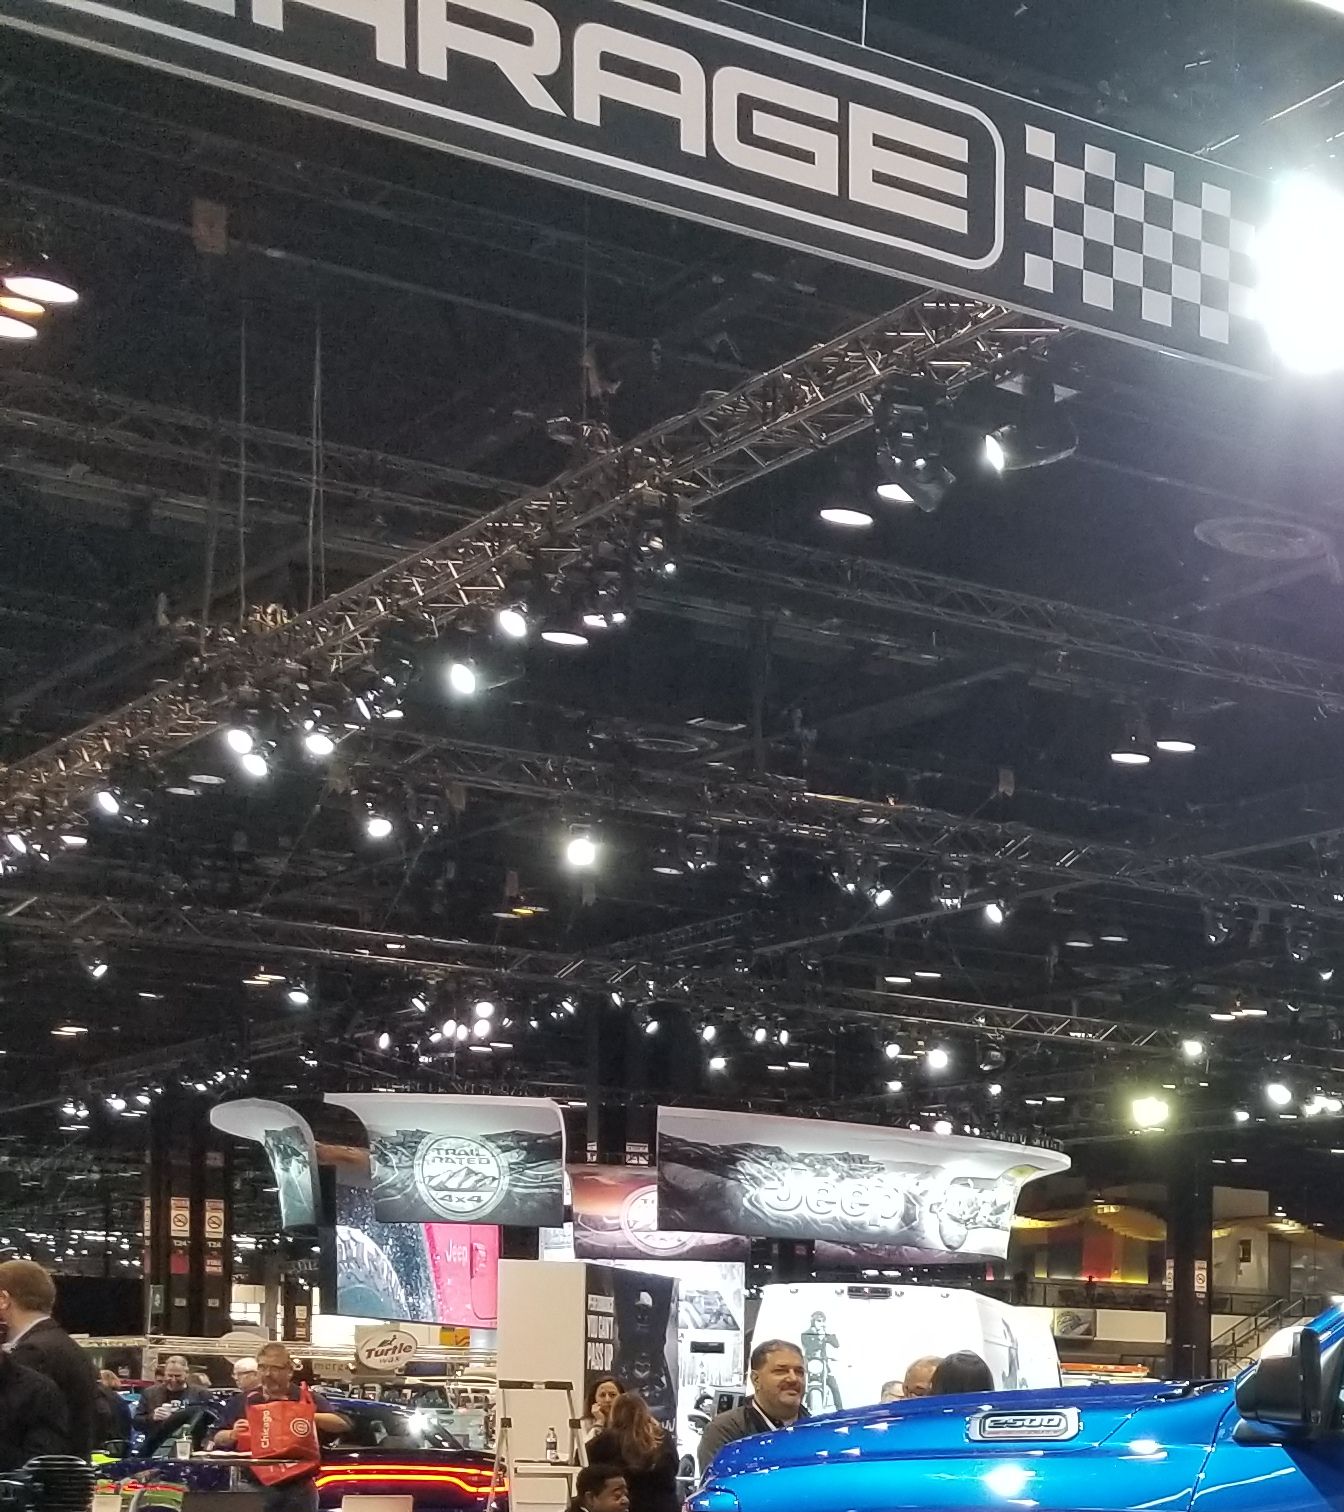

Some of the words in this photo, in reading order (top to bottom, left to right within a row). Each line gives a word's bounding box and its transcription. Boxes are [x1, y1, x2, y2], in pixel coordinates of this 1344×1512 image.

[174, 0, 968, 234] RAGE
[431, 1156, 491, 1165] RATED
[432, 1147, 487, 1156] TRAIL
[763, 1167, 902, 1228] Jeep
[445, 1239, 468, 1267] Jeep
[365, 1342, 413, 1360] Turtle
[260, 1410, 273, 1449] Chicago
[986, 1416, 1064, 1430] 2500
